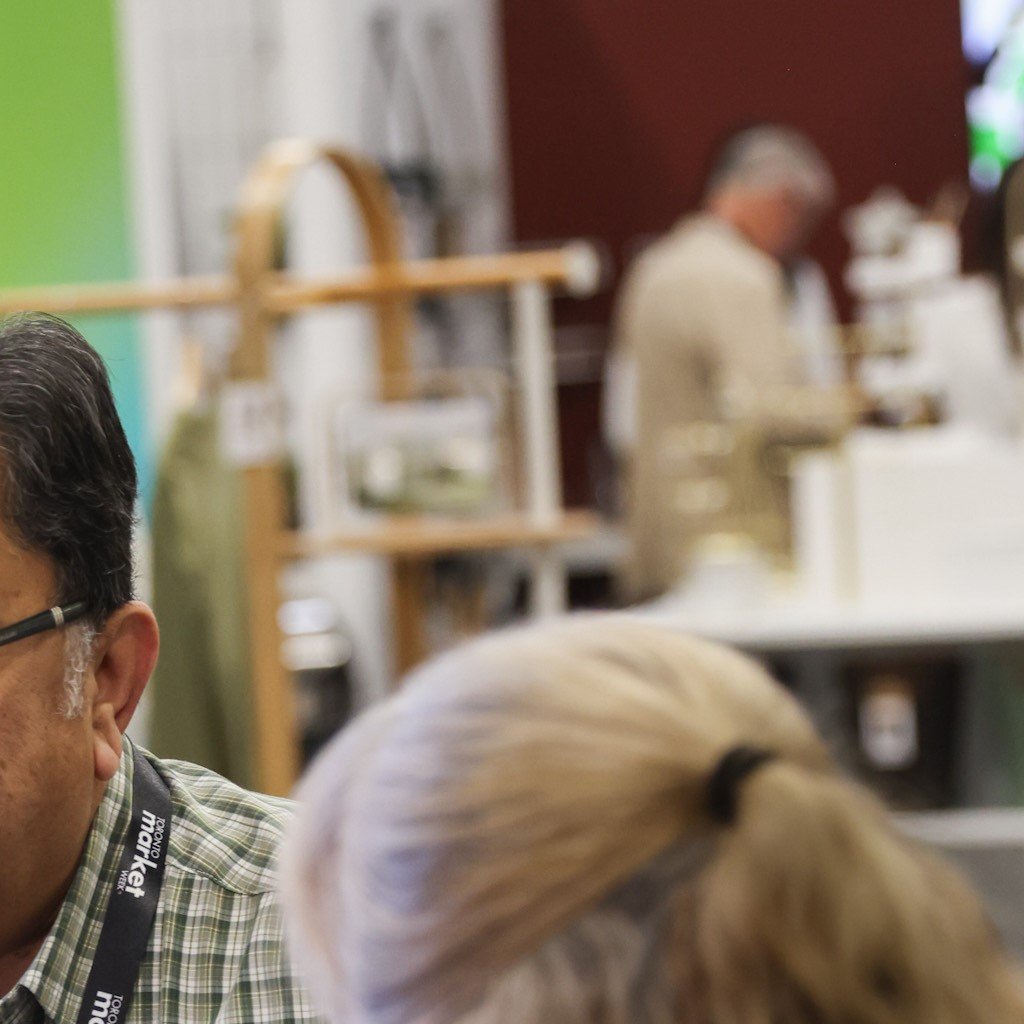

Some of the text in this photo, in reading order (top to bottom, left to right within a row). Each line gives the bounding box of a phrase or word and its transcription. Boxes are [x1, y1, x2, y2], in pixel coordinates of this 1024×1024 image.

[125, 809, 158, 898] market
[151, 816, 166, 859] TORONTO
[117, 870, 130, 892] WEEK
